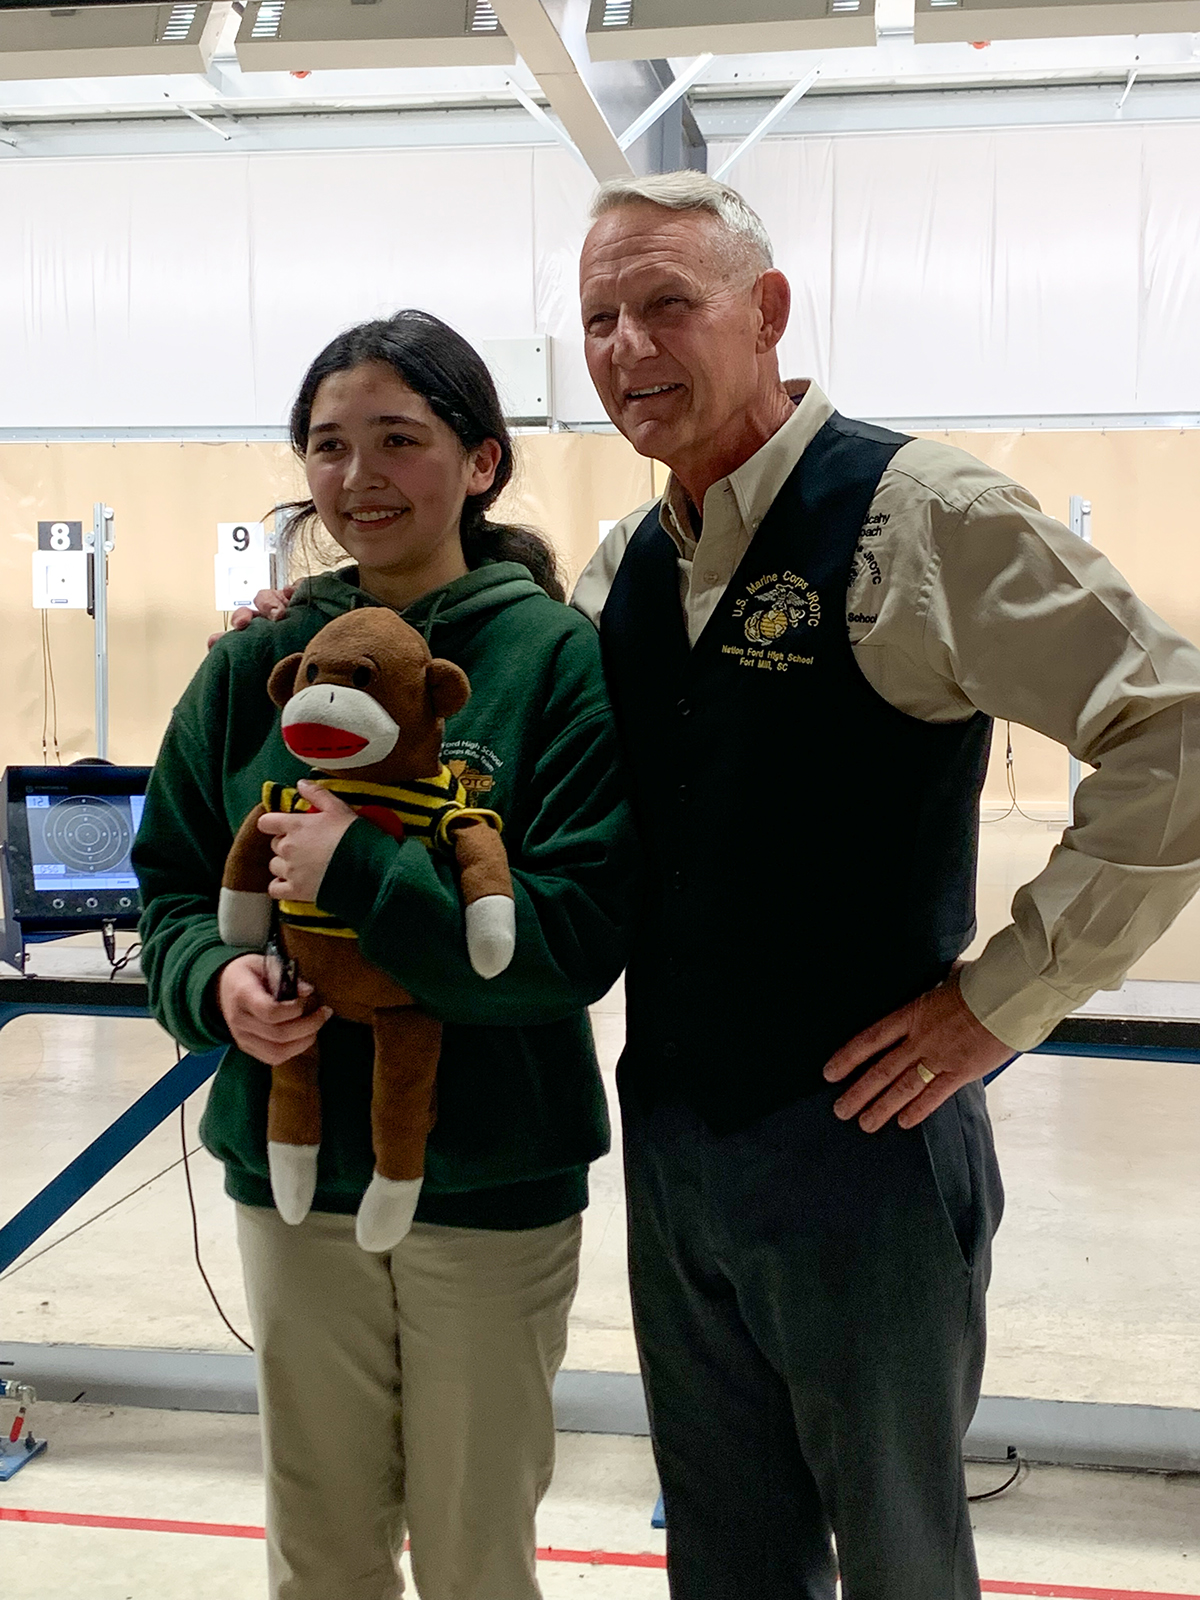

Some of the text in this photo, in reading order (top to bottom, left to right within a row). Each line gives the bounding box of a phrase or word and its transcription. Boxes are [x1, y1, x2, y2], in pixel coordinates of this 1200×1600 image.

[50, 523, 71, 550] 8
[232, 526, 250, 551] 9
[861, 525, 882, 537] oach
[863, 551, 882, 585] JROTC
[732, 570, 821, 627] U.S. Marine Corps JROTC
[848, 612, 878, 624] School
[721, 645, 814, 665] Nation Ford High School
[739, 657, 755, 667] Fort
[776, 662, 788, 672] SC
[480, 745, 504, 768] School
[460, 778, 491, 787] OTC
